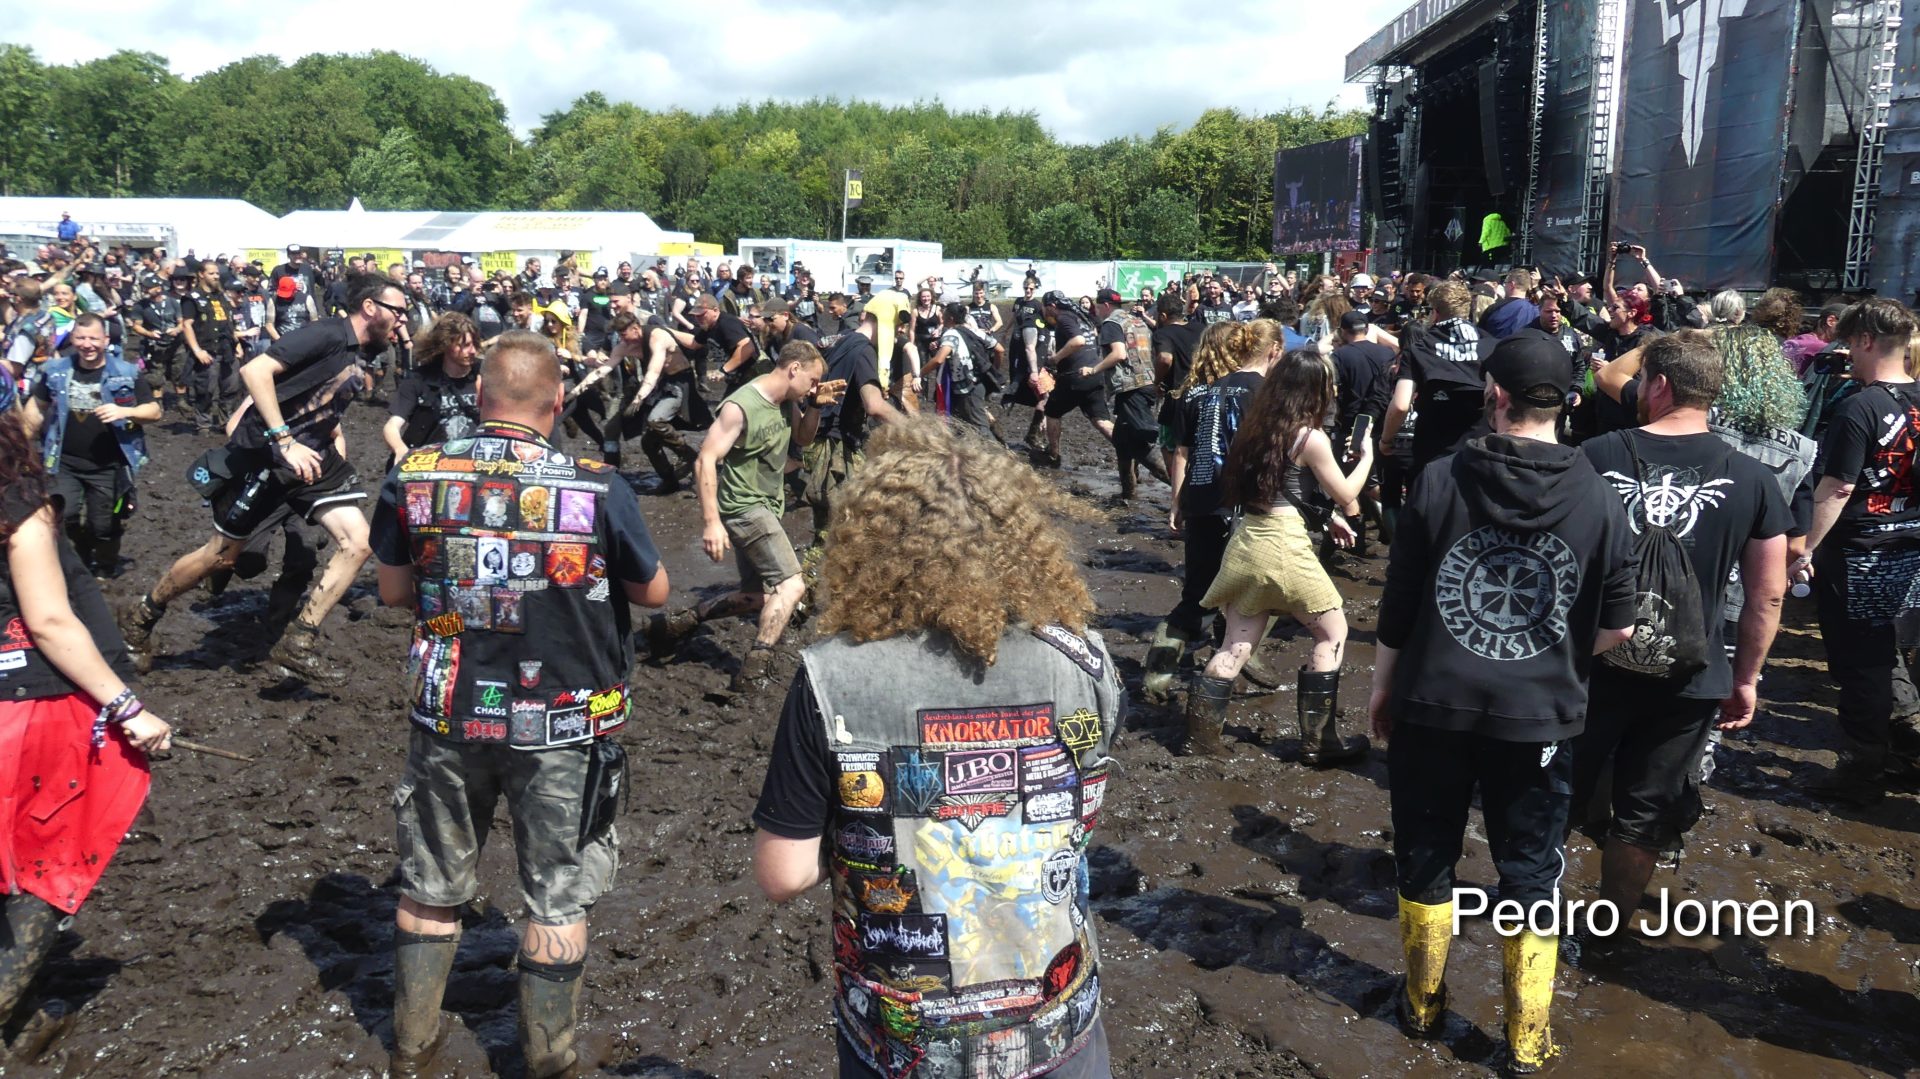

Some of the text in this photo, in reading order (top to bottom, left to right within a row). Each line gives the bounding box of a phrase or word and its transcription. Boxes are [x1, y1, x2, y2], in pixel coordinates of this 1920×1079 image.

[542, 467, 574, 477] POSITIV
[427, 611, 465, 637] KISS
[474, 706, 507, 716] CHAOS
[924, 716, 1051, 744] KNORKATOR
[838, 753, 879, 762] SCHWARZES
[841, 762, 876, 771] FREIBURG
[949, 752, 1012, 784] J.B.O.
[1025, 771, 1043, 781] METAL
